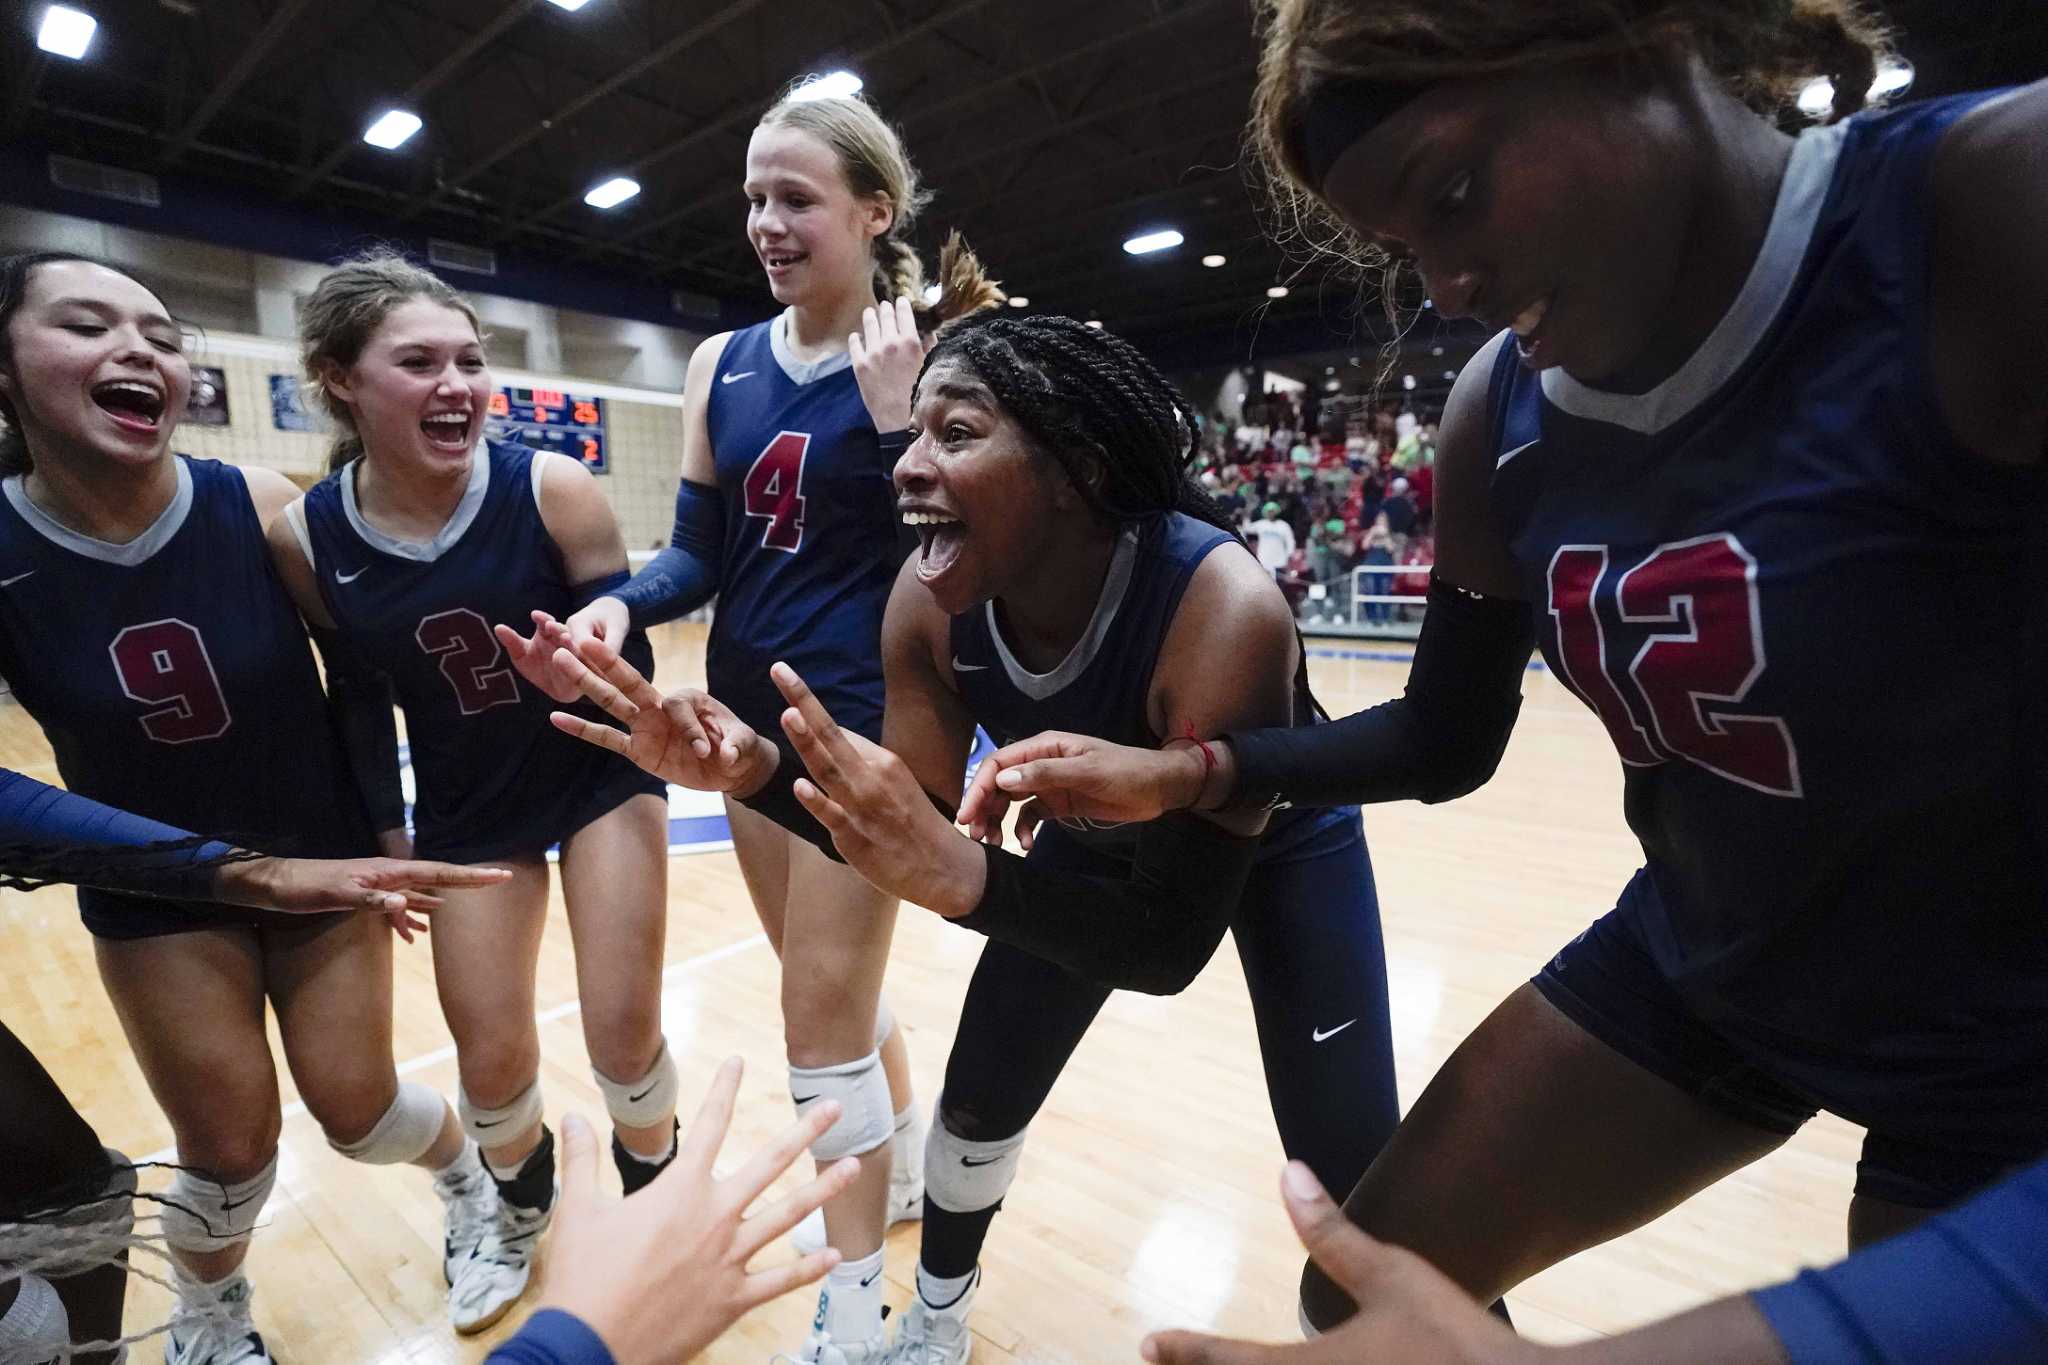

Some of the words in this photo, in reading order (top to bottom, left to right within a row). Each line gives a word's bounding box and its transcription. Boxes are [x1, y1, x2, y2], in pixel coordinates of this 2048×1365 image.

[584, 440, 598, 461] 2
[743, 430, 812, 554] 4
[108, 617, 232, 744] 9
[415, 607, 521, 716] 2
[1547, 531, 1803, 798] 12
